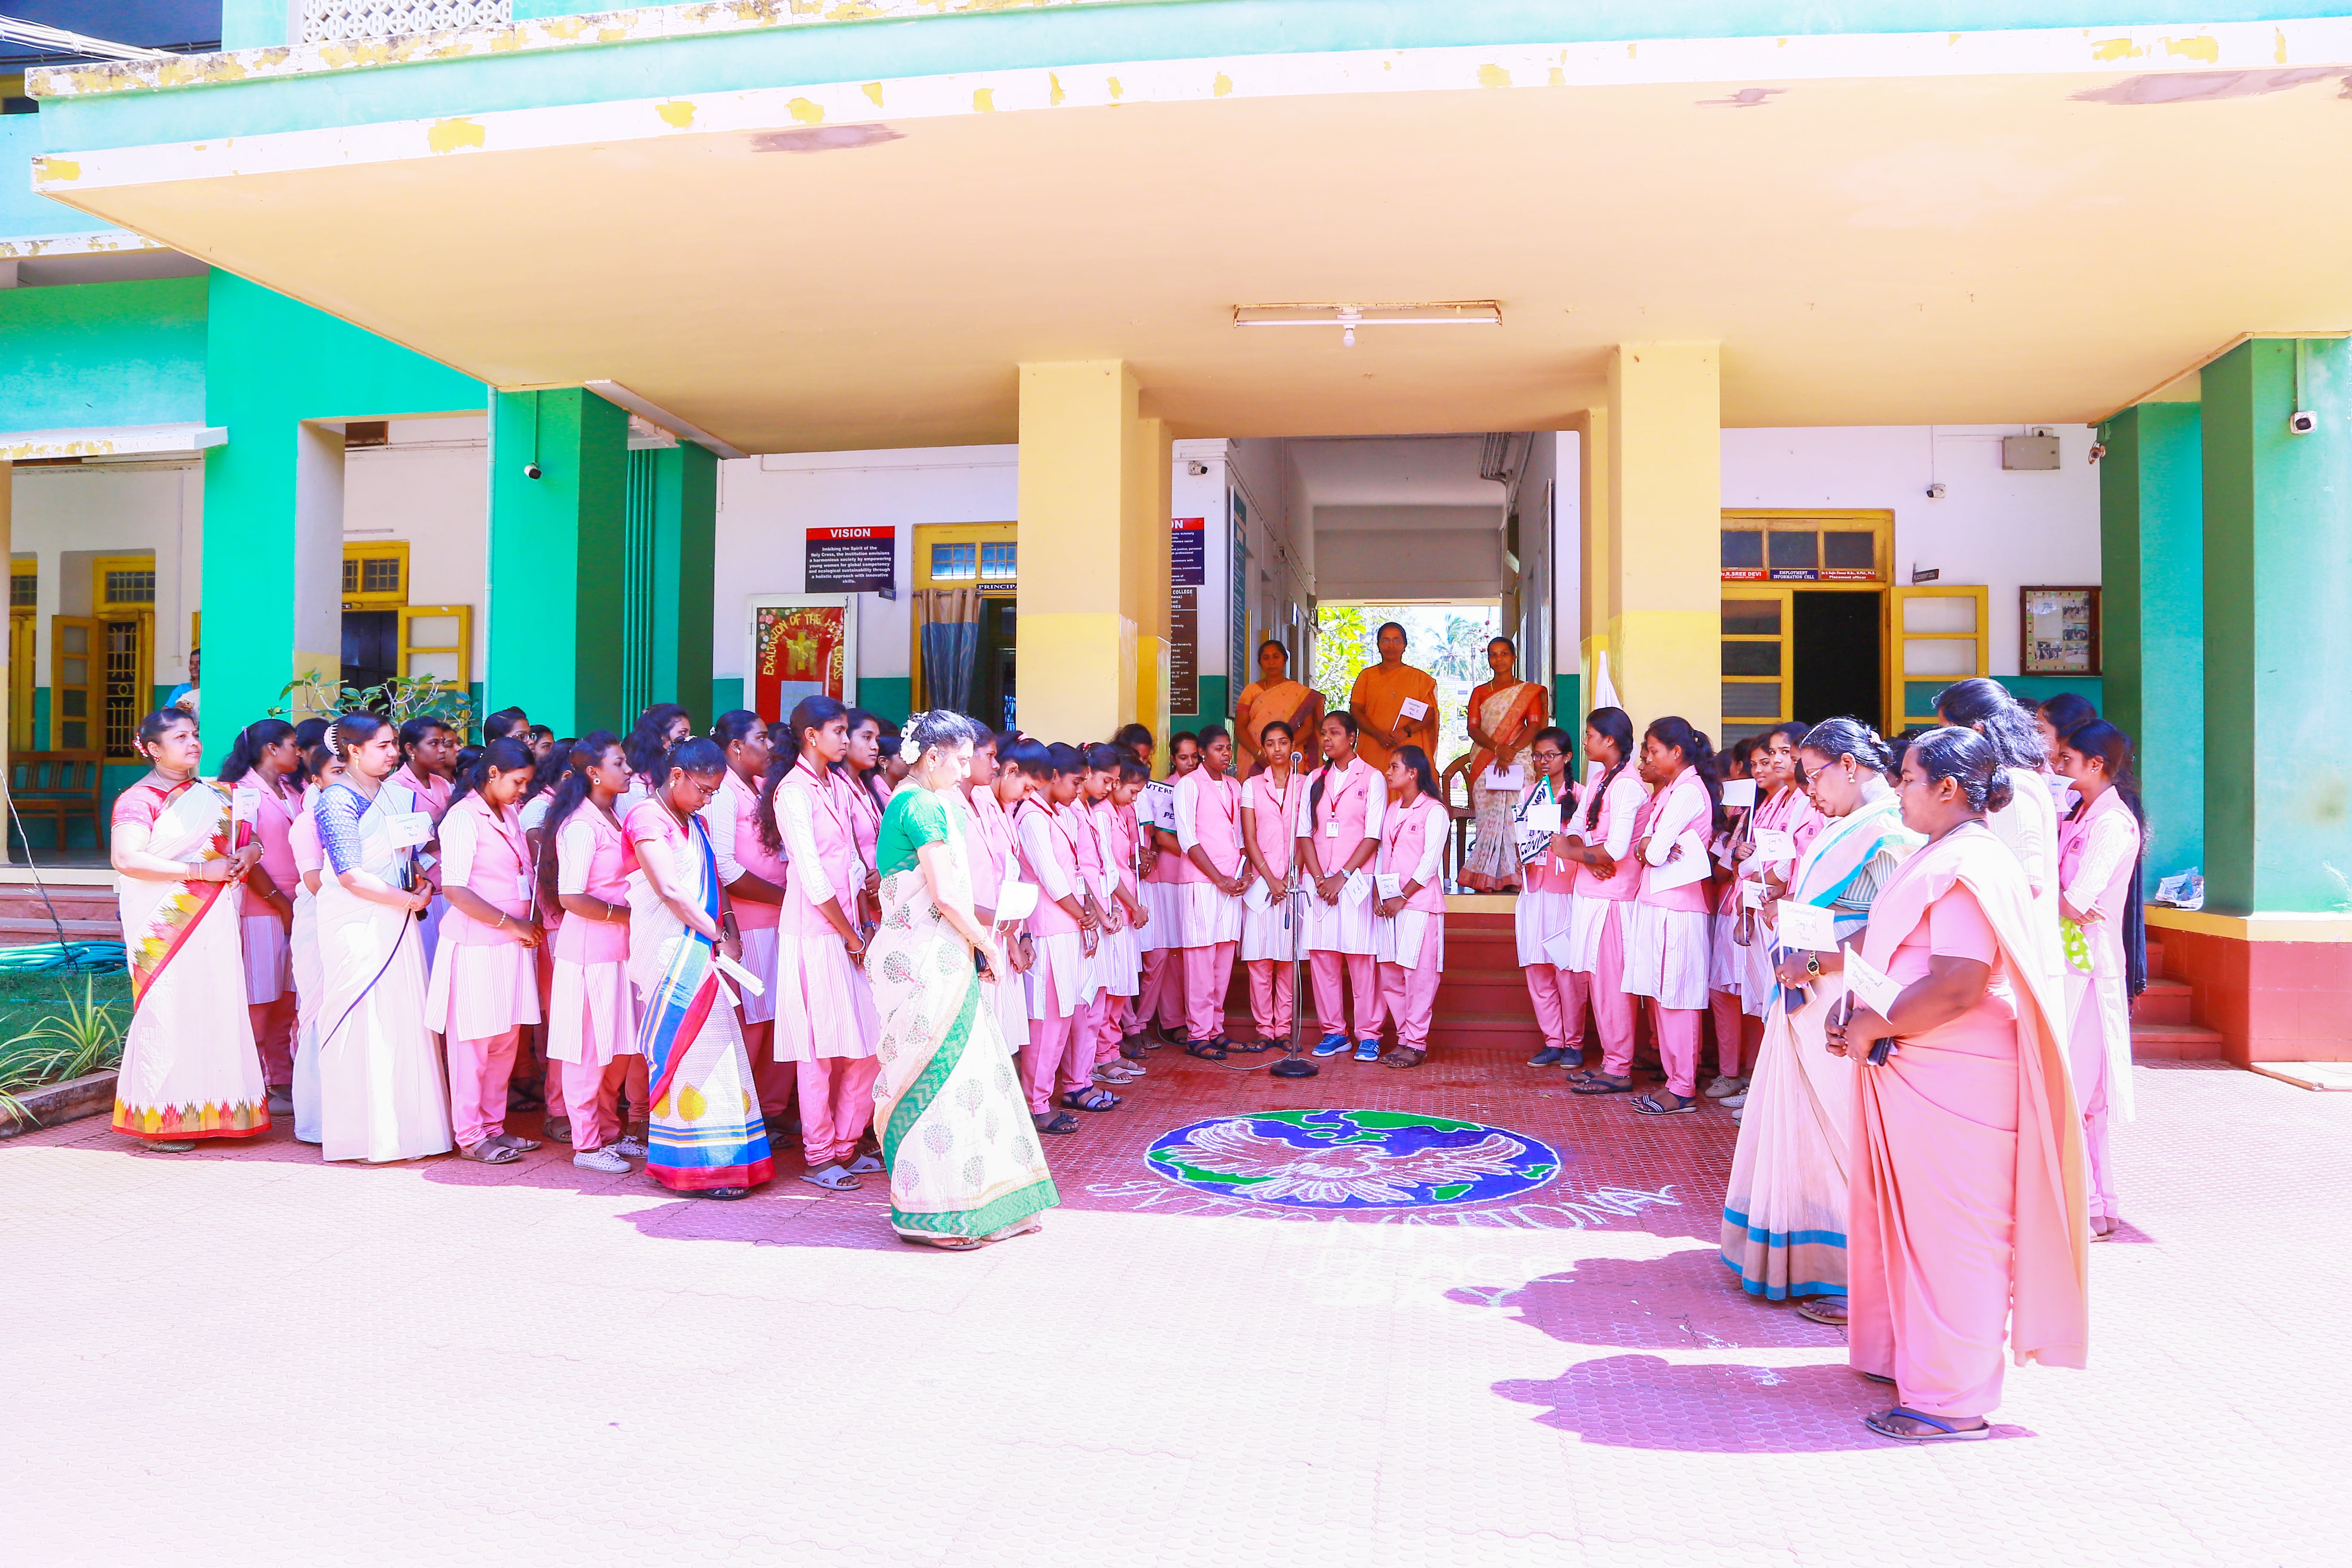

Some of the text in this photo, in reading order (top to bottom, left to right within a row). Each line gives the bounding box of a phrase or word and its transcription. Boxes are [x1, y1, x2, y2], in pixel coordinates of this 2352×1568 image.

[830, 528, 870, 537] VISION
[763, 620, 788, 676] EXALTATION
[790, 613, 801, 626] OF
[805, 614, 821, 625] THE
[833, 645, 843, 680] CROSS
[1785, 906, 1817, 916] International
